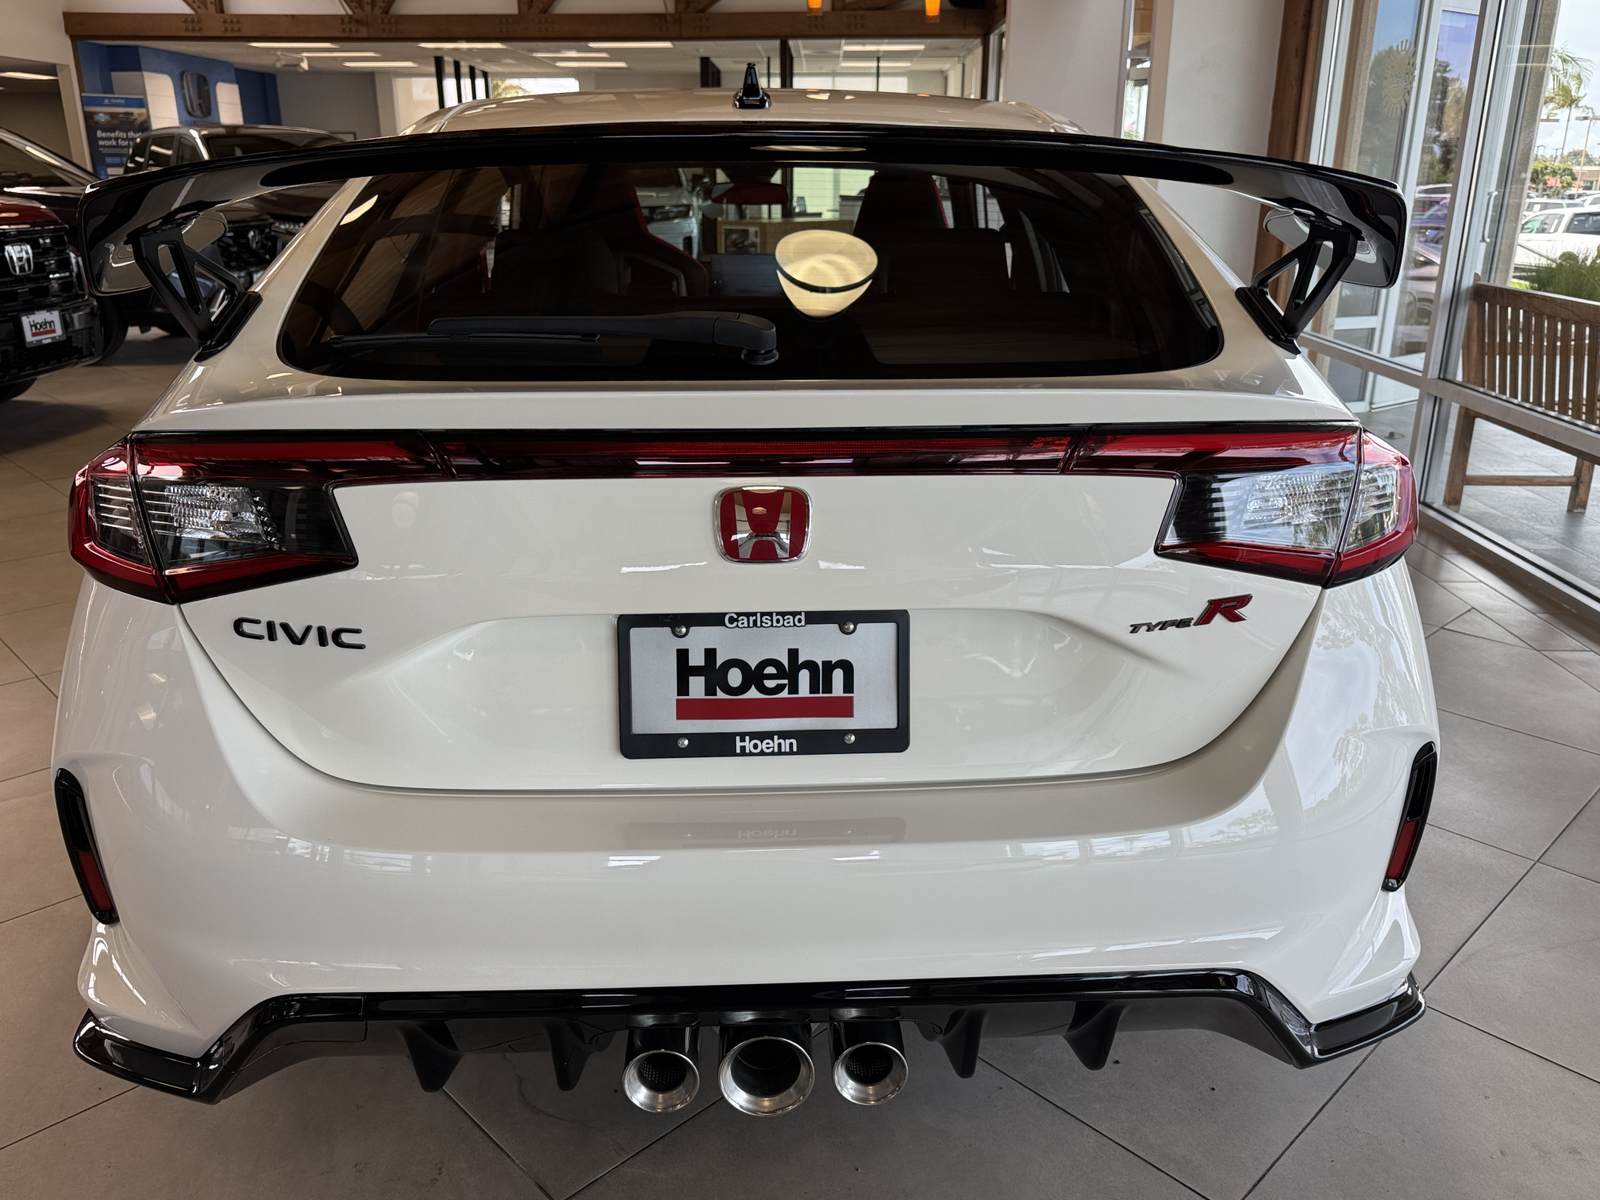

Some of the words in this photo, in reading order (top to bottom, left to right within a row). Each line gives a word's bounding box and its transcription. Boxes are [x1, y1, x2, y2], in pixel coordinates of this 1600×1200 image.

[96, 130, 127, 138] Benefits
[118, 138, 128, 146] for
[28, 318, 55, 332] Hoehn
[724, 612, 806, 628] Carlsbad
[1129, 617, 1194, 634] TYPE
[1193, 593, 1253, 626] R
[233, 617, 366, 649] CIVIC
[676, 648, 854, 696] Hoehn
[735, 735, 797, 753] Hoehn
